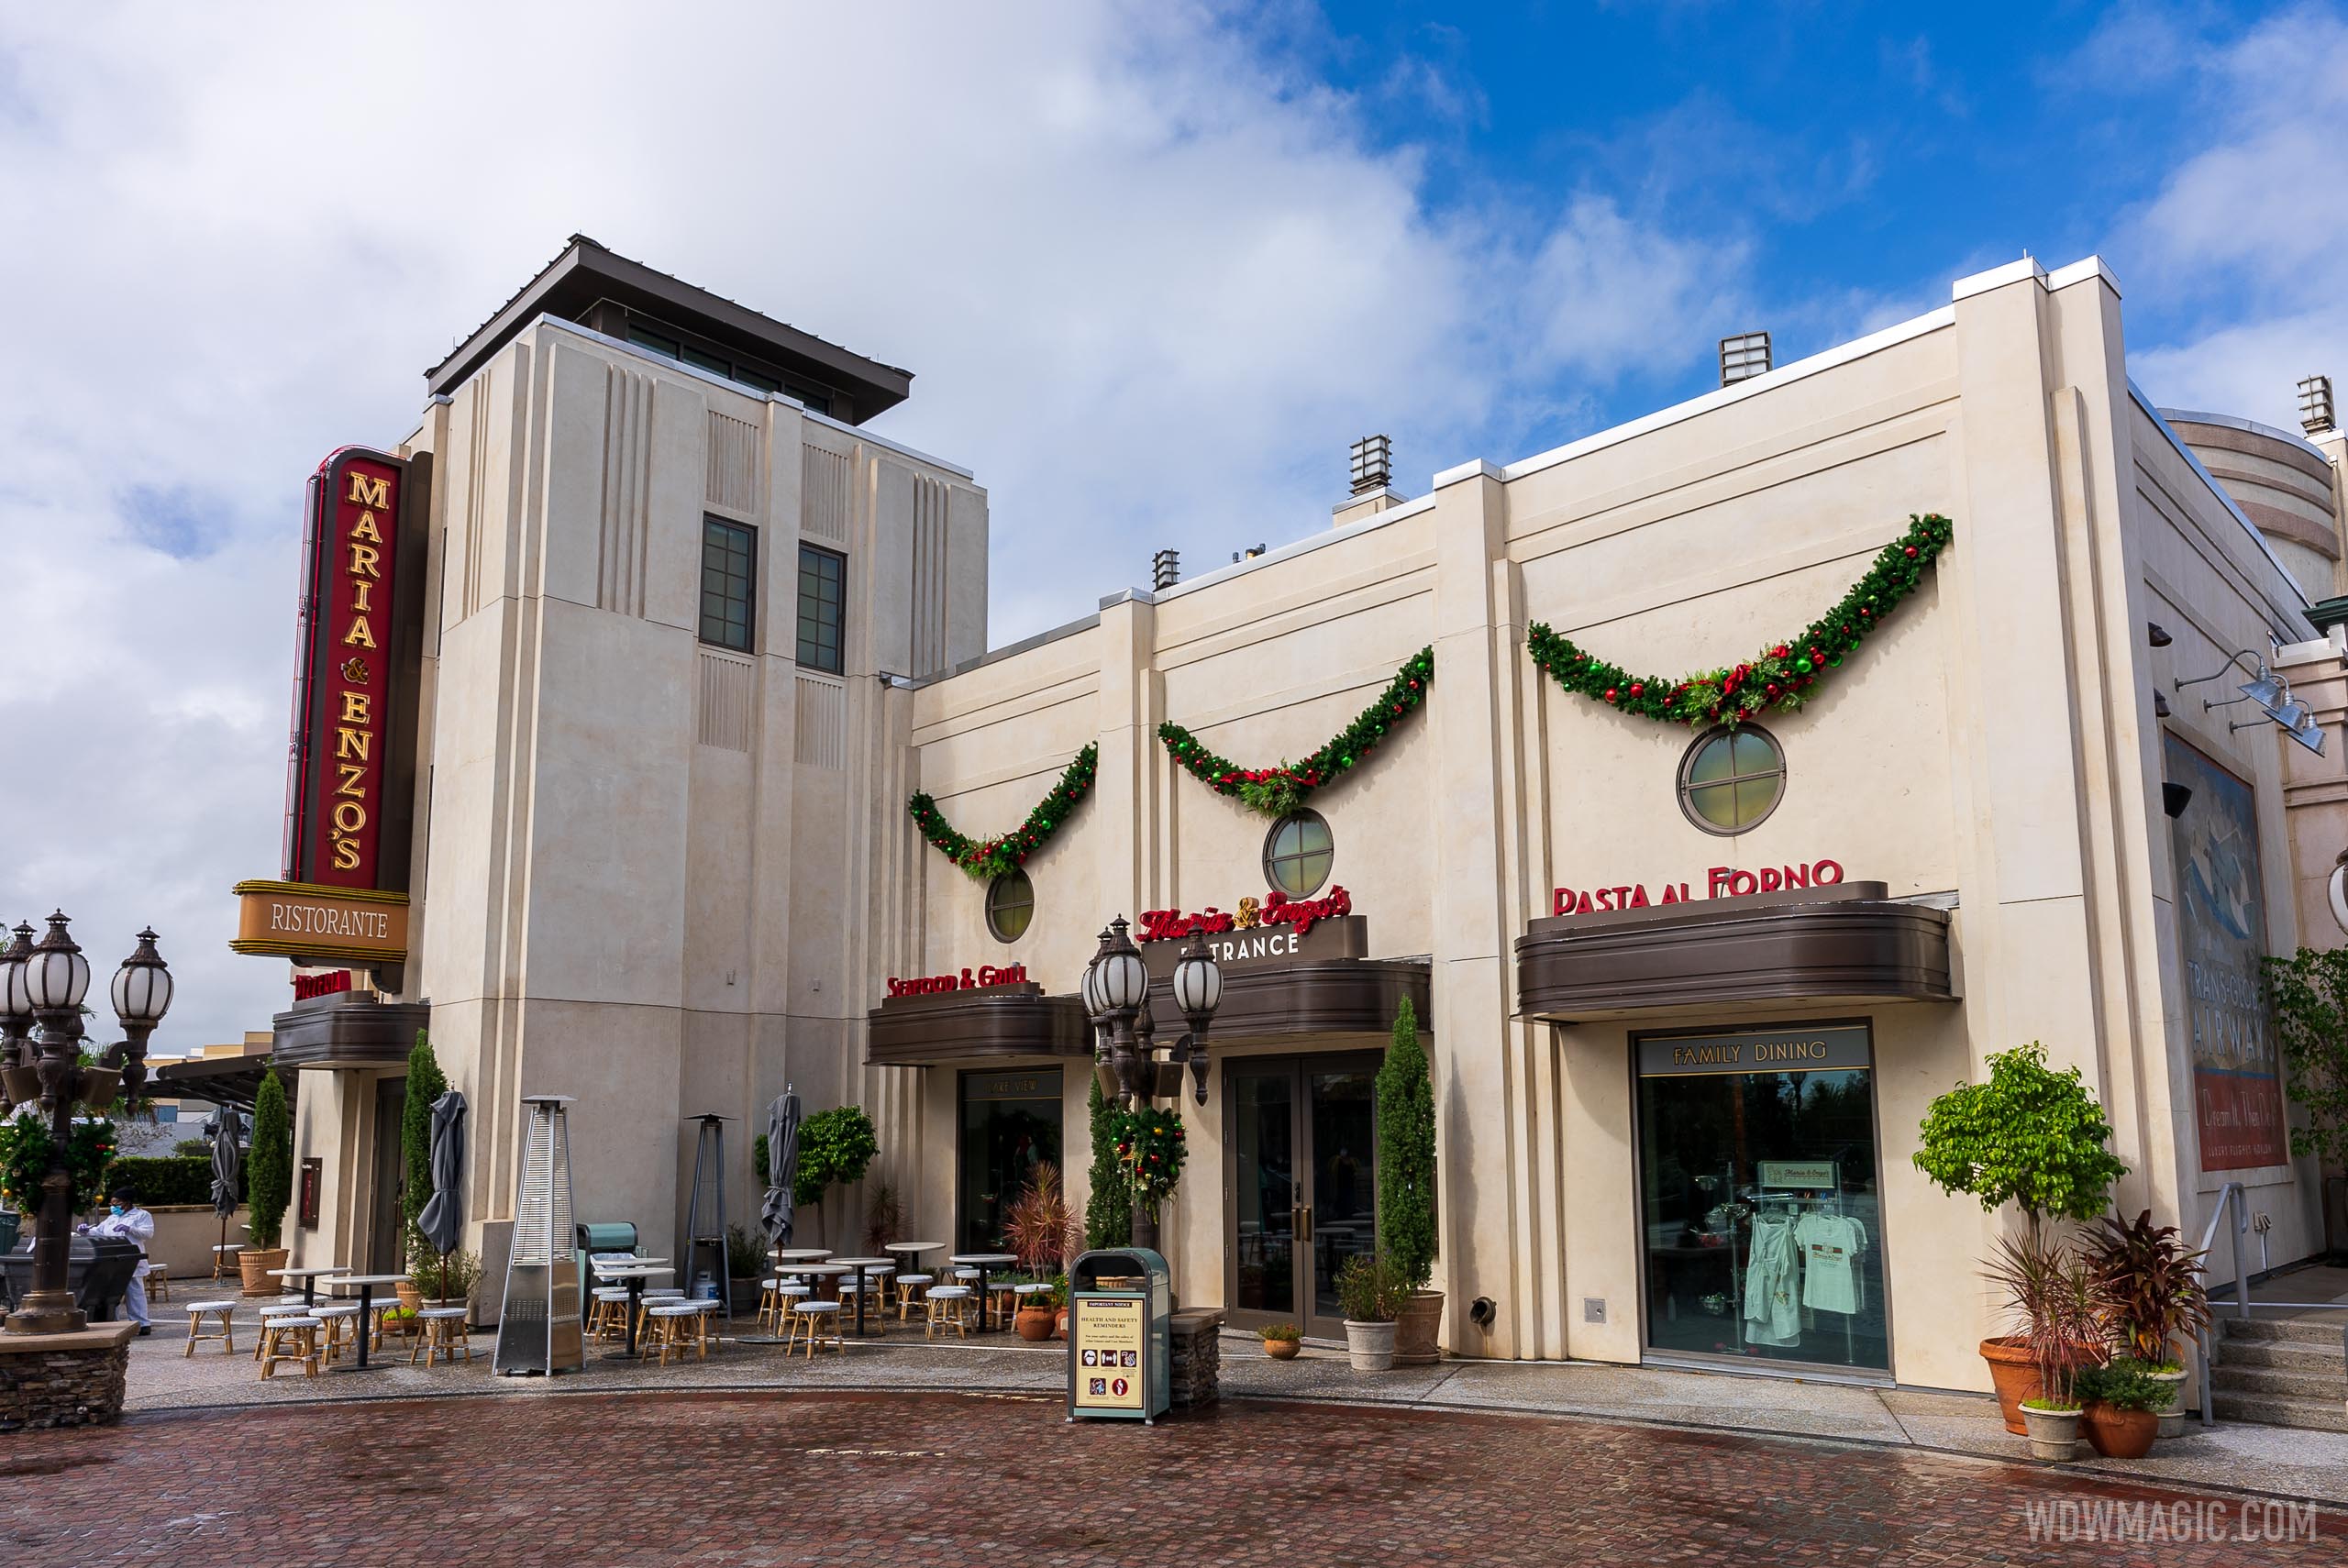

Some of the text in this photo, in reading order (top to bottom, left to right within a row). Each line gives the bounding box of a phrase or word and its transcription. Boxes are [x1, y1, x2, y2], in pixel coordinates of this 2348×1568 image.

[327, 470, 391, 870] MARIA & ENZO'S
[1553, 859, 1845, 918] PASTA AL FORNO
[271, 902, 389, 940] RISTORANTE
[1233, 896, 1263, 929] &
[1180, 933, 1300, 963] TRANCE
[887, 965, 1027, 999] SEAFOOD & GRILL
[2193, 1005, 2276, 1064] AIRWAYS
[1672, 1040, 1827, 1066] FAMILY DINING
[1013, 1077, 1038, 1093] VIEW
